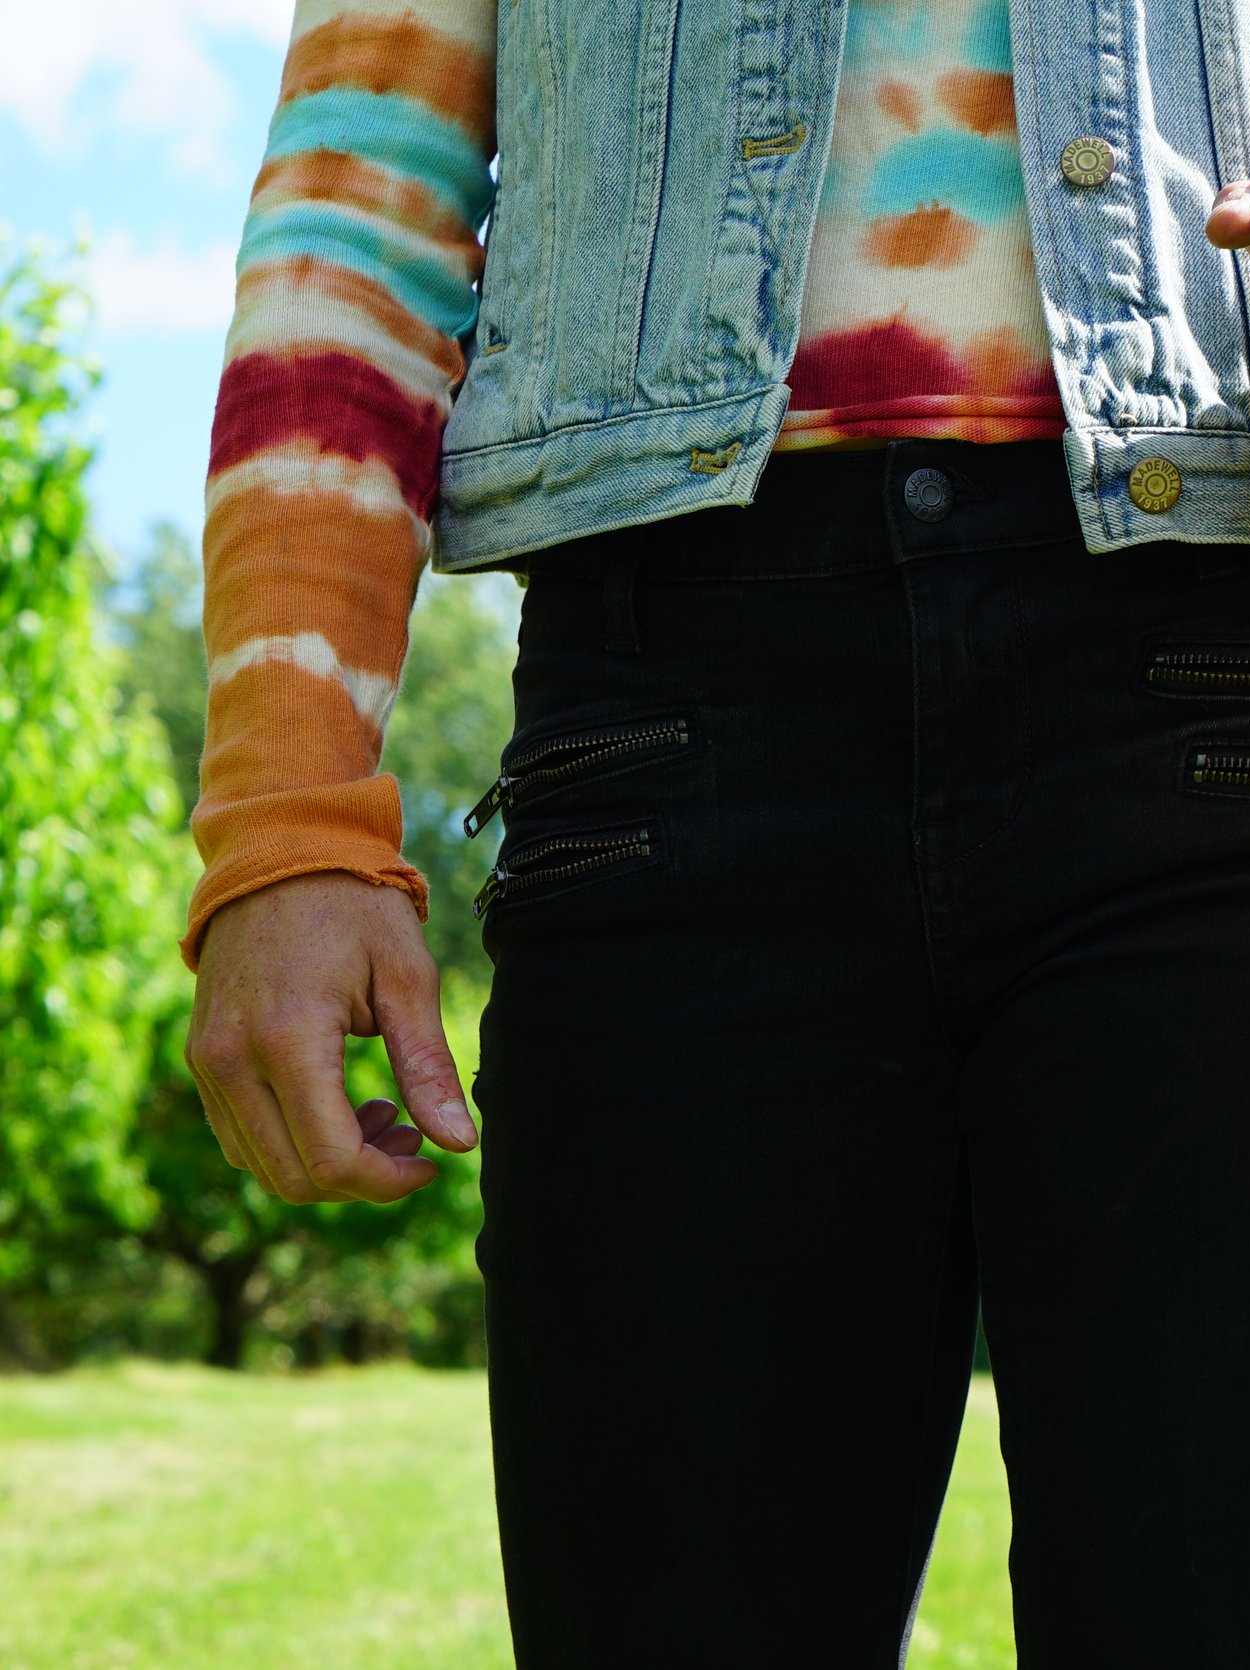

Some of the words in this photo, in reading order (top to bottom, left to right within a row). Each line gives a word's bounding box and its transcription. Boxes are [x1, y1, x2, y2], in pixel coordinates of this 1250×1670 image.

[1063, 138, 1112, 175] MADEWELL
[1080, 163, 1110, 184] 1937
[1131, 460, 1180, 493] MADEWELL
[1137, 494, 1168, 511] 1937
